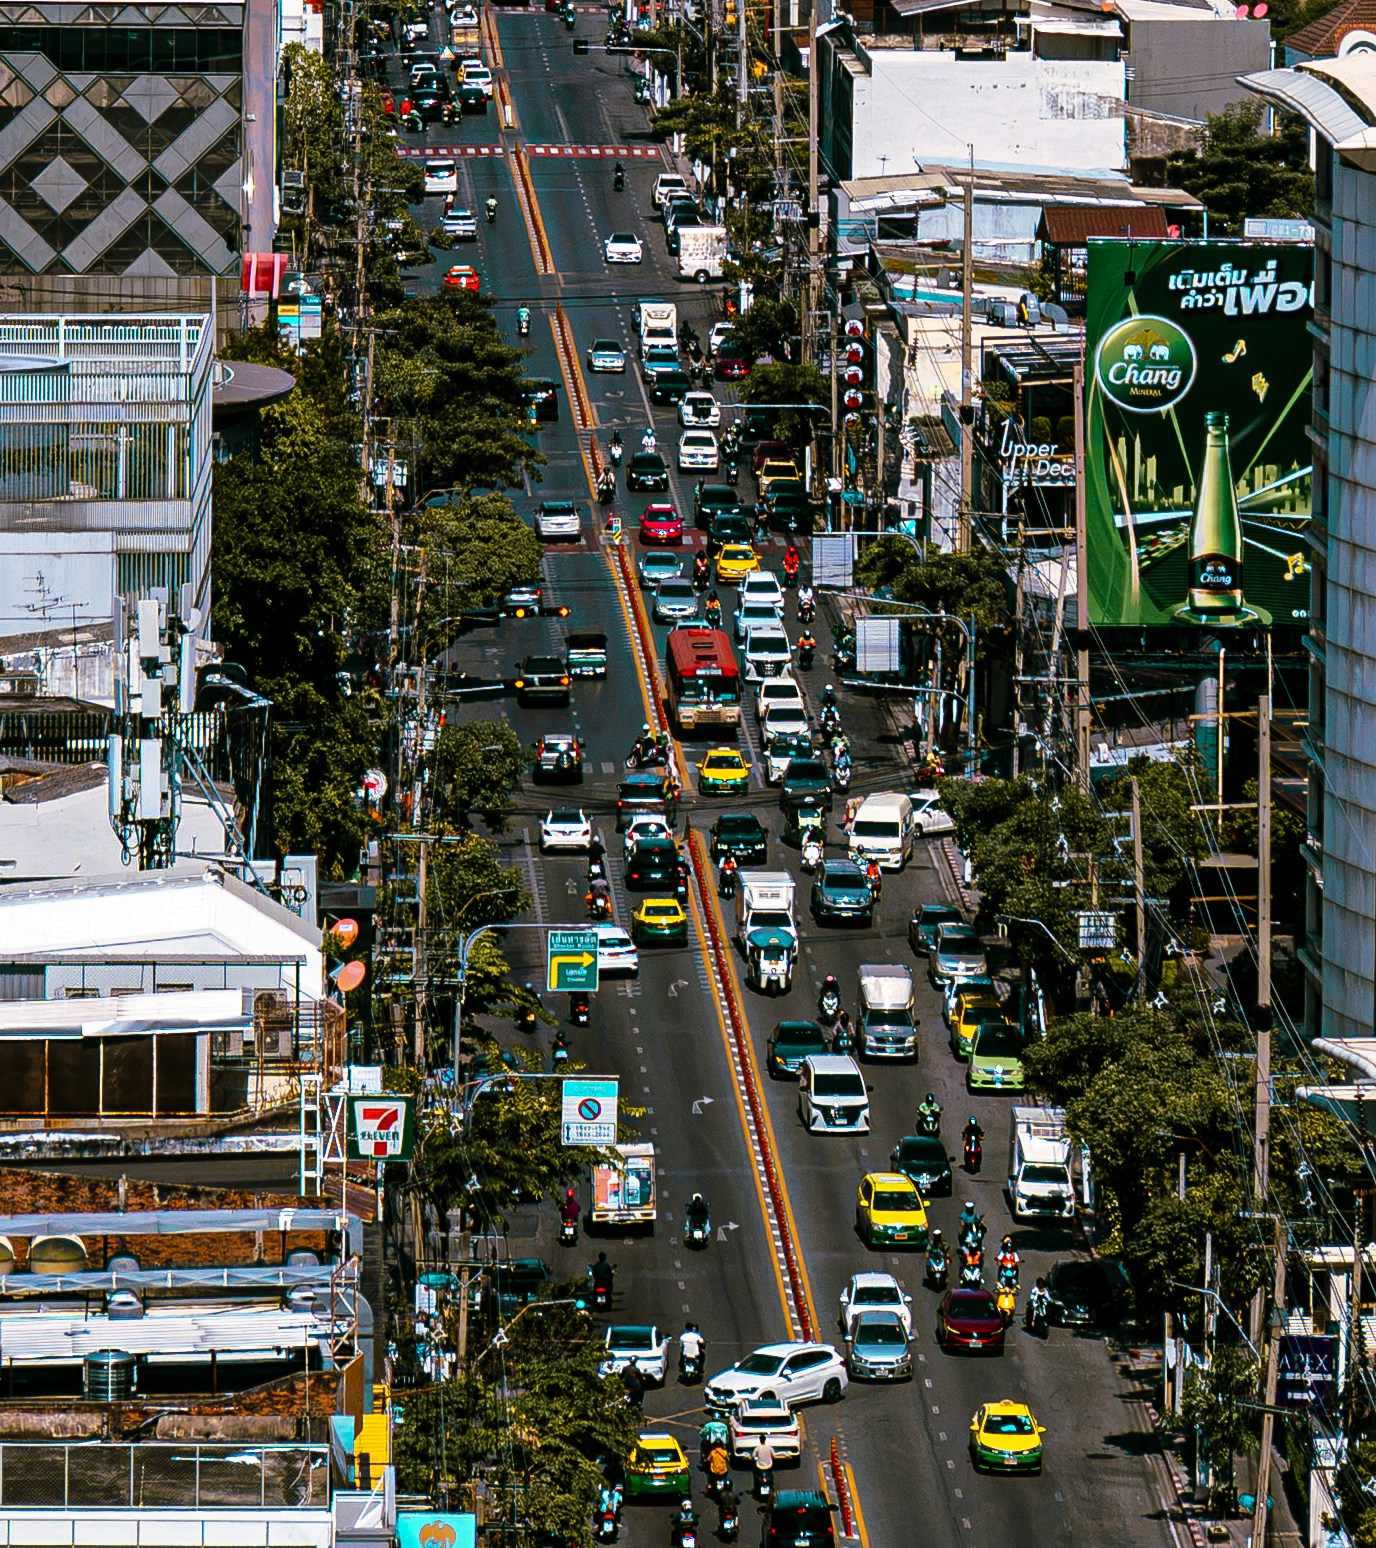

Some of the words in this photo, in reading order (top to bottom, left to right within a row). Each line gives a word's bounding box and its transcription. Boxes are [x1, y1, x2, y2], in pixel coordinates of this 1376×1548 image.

[1108, 362, 1182, 390] Chang
[1129, 387, 1162, 397] MINERAL
[1200, 573, 1232, 585] Chang
[362, 1108, 398, 1156] 7
[1279, 1353, 1329, 1372] APEX
